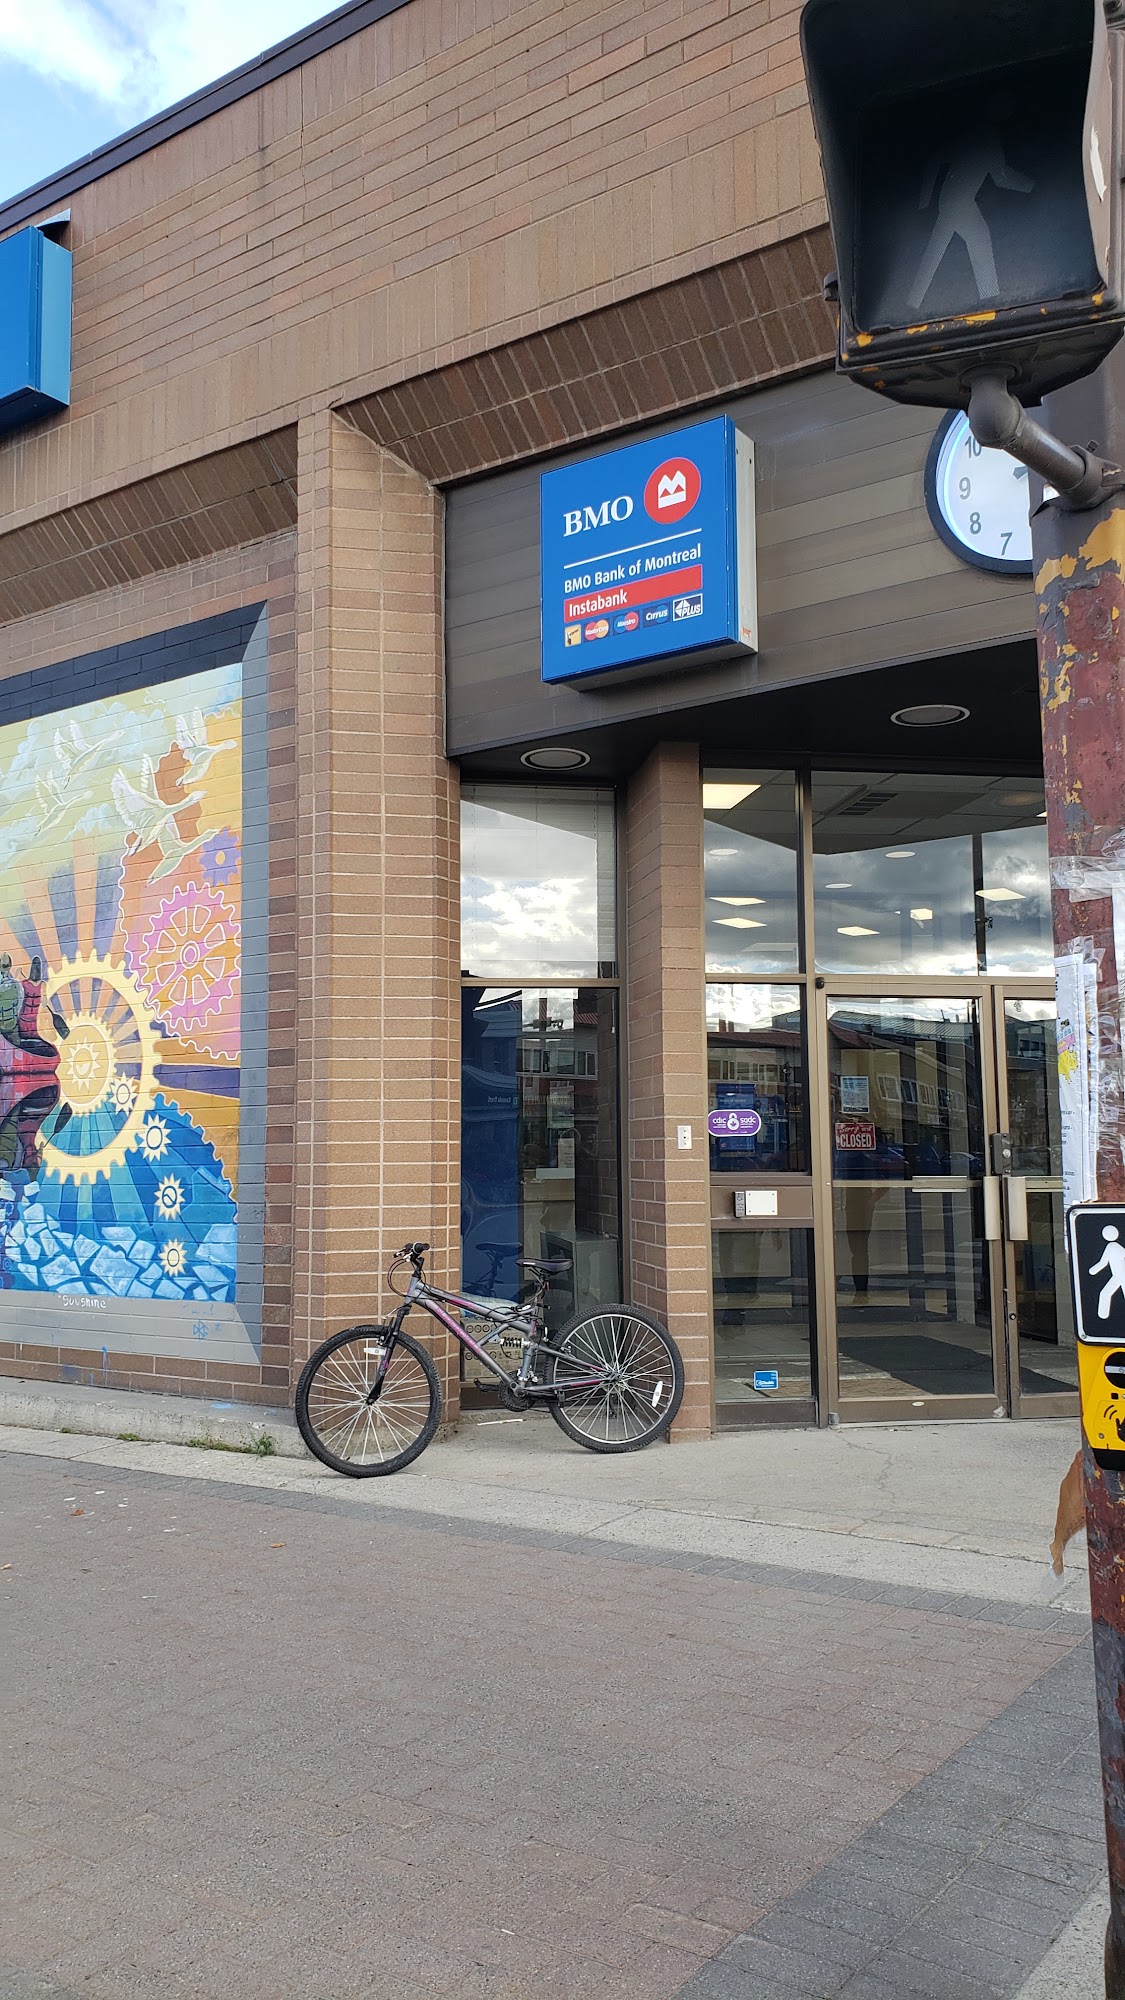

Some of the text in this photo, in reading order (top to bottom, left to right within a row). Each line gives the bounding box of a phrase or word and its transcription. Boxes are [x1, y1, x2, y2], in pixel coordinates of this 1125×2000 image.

[959, 476, 971, 500] 9
[563, 495, 634, 537] BMO
[969, 512, 982, 535] 8
[1000, 532, 1013, 556] 7
[564, 543, 701, 594] BMO Bank of Montreal
[568, 589, 628, 617] Instabank
[682, 603, 701, 617] PLUS
[646, 609, 668, 621] Cirrus
[740, 1115, 757, 1124] sadc
[839, 1124, 860, 1135] Sorry
[840, 1133, 872, 1148] CLOSED
